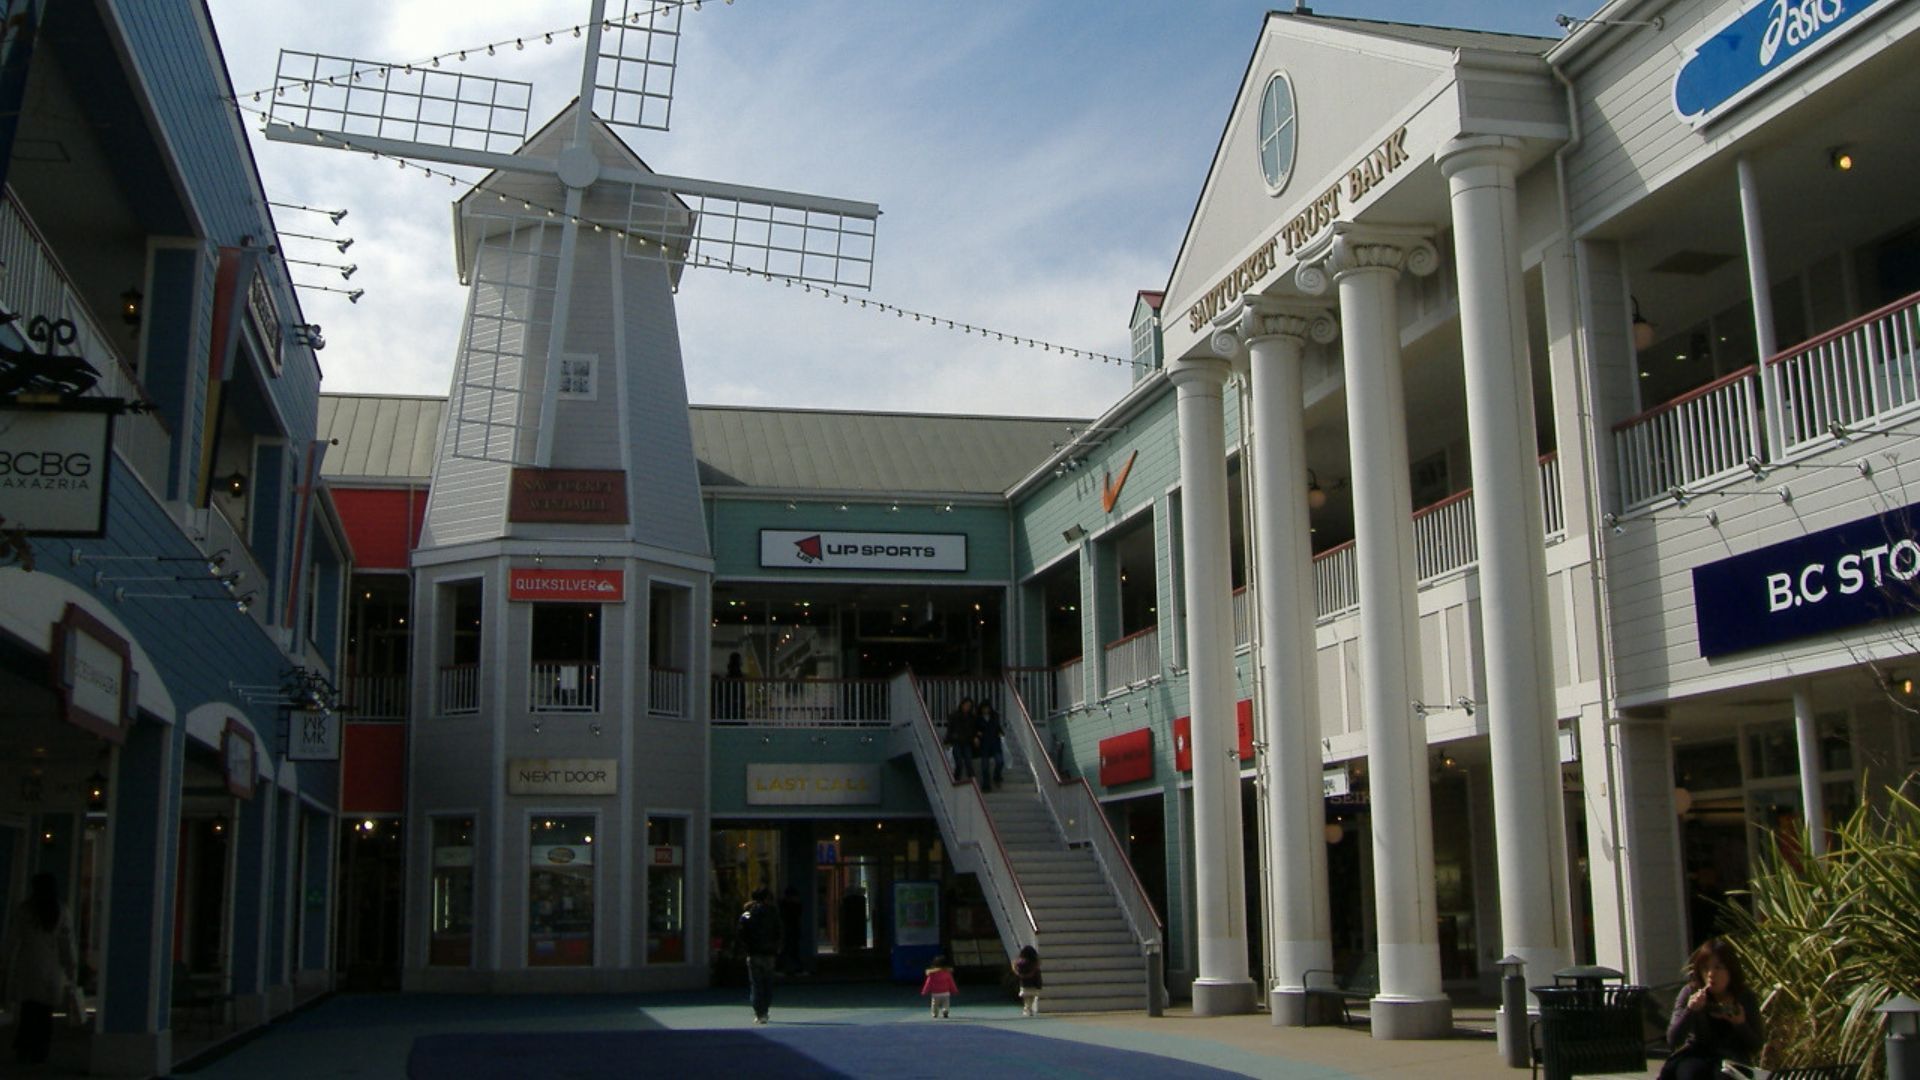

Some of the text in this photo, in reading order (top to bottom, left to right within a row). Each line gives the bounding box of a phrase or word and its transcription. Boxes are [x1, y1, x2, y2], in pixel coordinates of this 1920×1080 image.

[1190, 125, 1409, 333] SAWTUCKET TRUST BANK
[862, 545, 936, 557] SPORTS
[515, 578, 598, 592] QUIKSILVER
[1766, 563, 1829, 613] B.C
[519, 770, 607, 783] NEXT DOOR
[755, 776, 872, 792] LAST CALL
